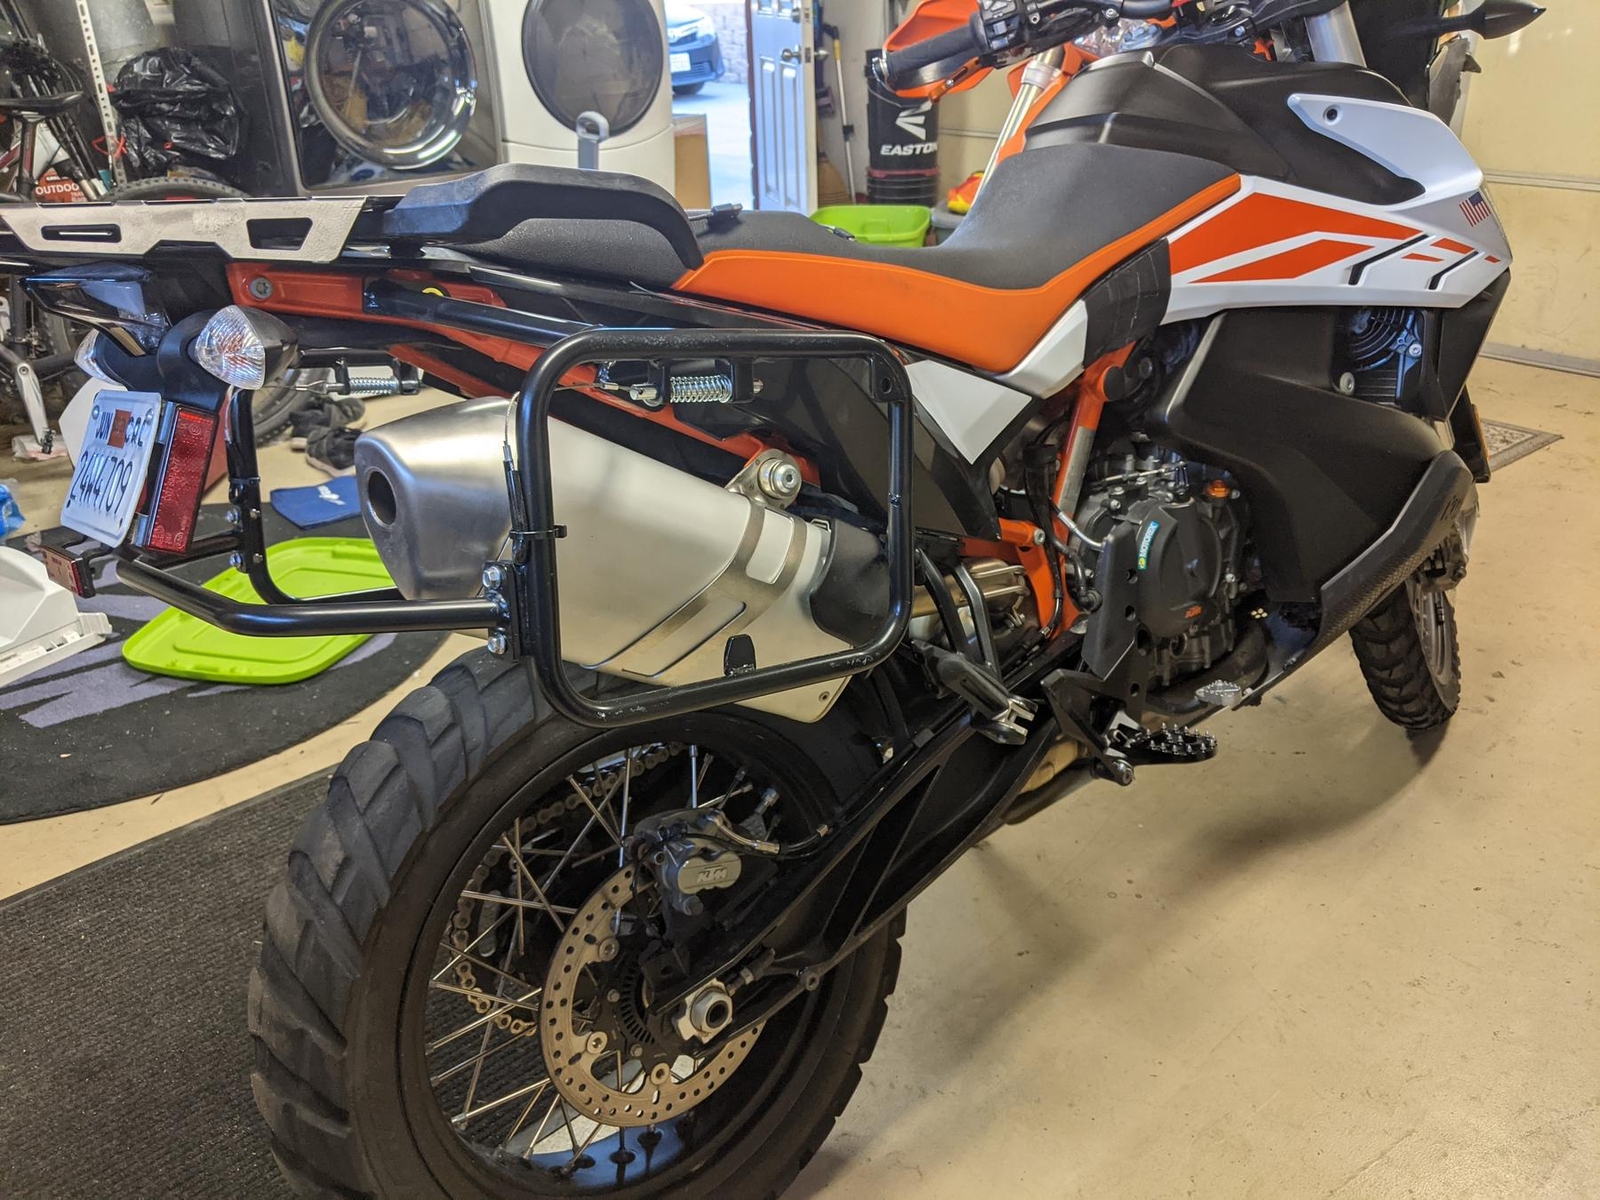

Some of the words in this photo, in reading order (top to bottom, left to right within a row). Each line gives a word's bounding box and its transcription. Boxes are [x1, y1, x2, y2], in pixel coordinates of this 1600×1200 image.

[35, 183, 80, 195] OUTDOO
[95, 411, 114, 440] JUN
[70, 450, 133, 514] 24W4709
[697, 864, 728, 884] KTM
